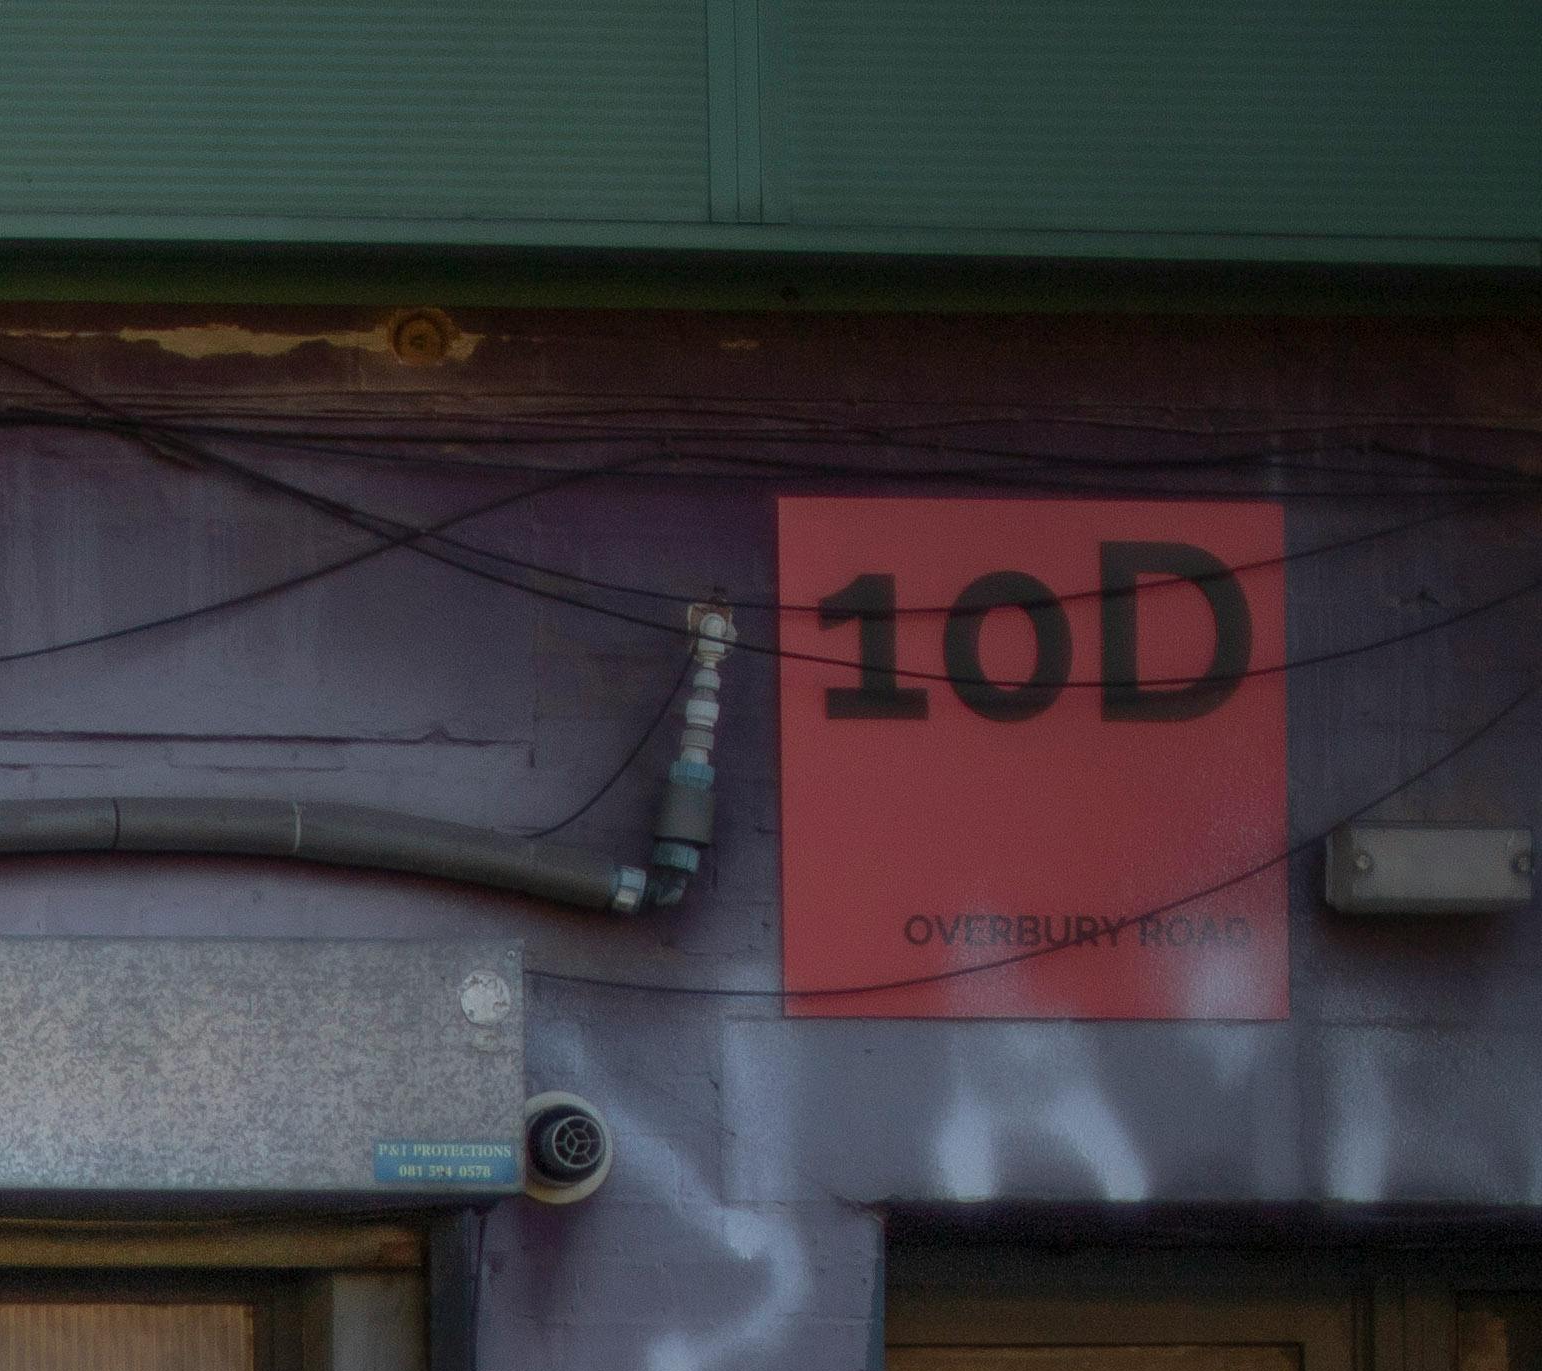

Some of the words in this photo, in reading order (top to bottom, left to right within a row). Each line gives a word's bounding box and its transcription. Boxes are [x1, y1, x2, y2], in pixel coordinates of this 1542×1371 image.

[818, 540, 1253, 723] 10D
[904, 913, 1128, 949] OVERBURY
[1137, 913, 1253, 949] ROAD
[412, 1143, 512, 1158] PROTECTIONS
